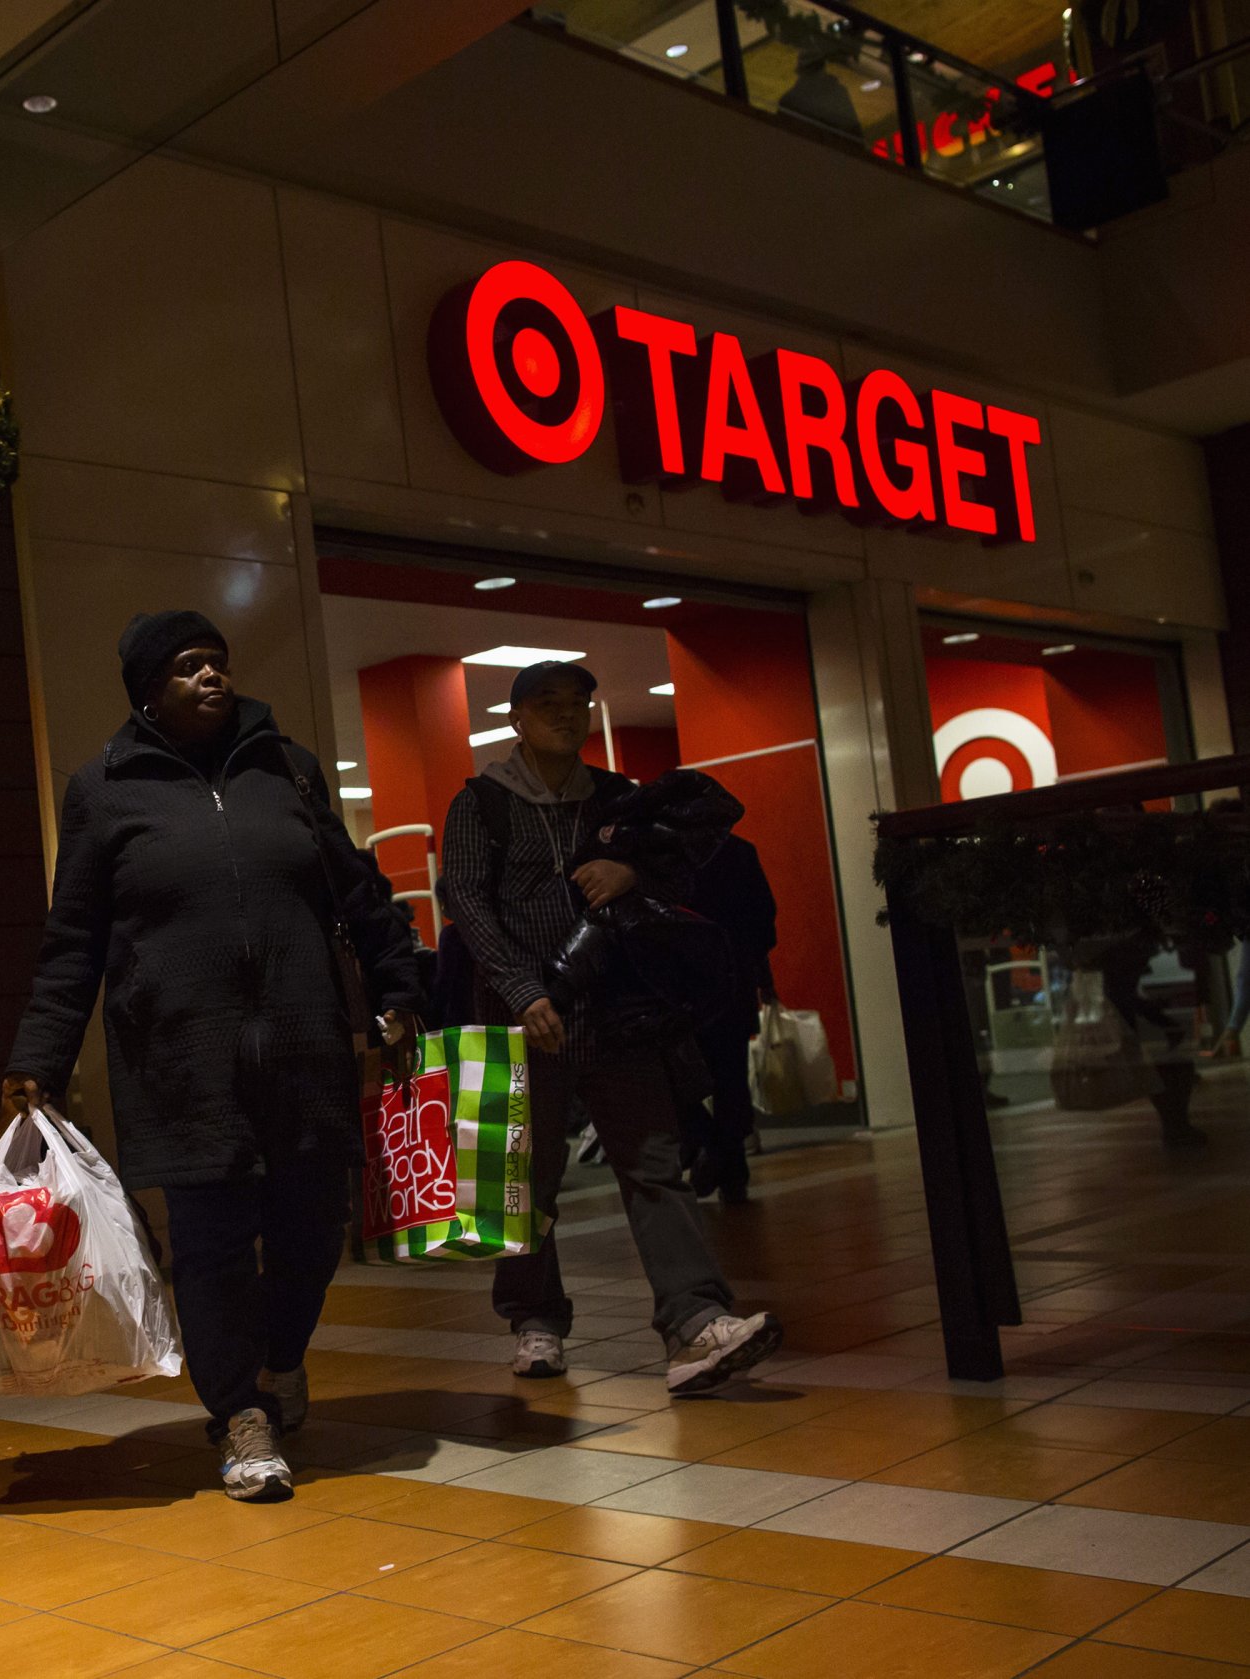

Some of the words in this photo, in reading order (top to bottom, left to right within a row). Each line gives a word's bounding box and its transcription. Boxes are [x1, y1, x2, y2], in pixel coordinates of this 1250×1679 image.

[614, 305, 1042, 543] TARGET
[509, 1063, 525, 1118] Works
[506, 1179, 520, 1217] Bath
